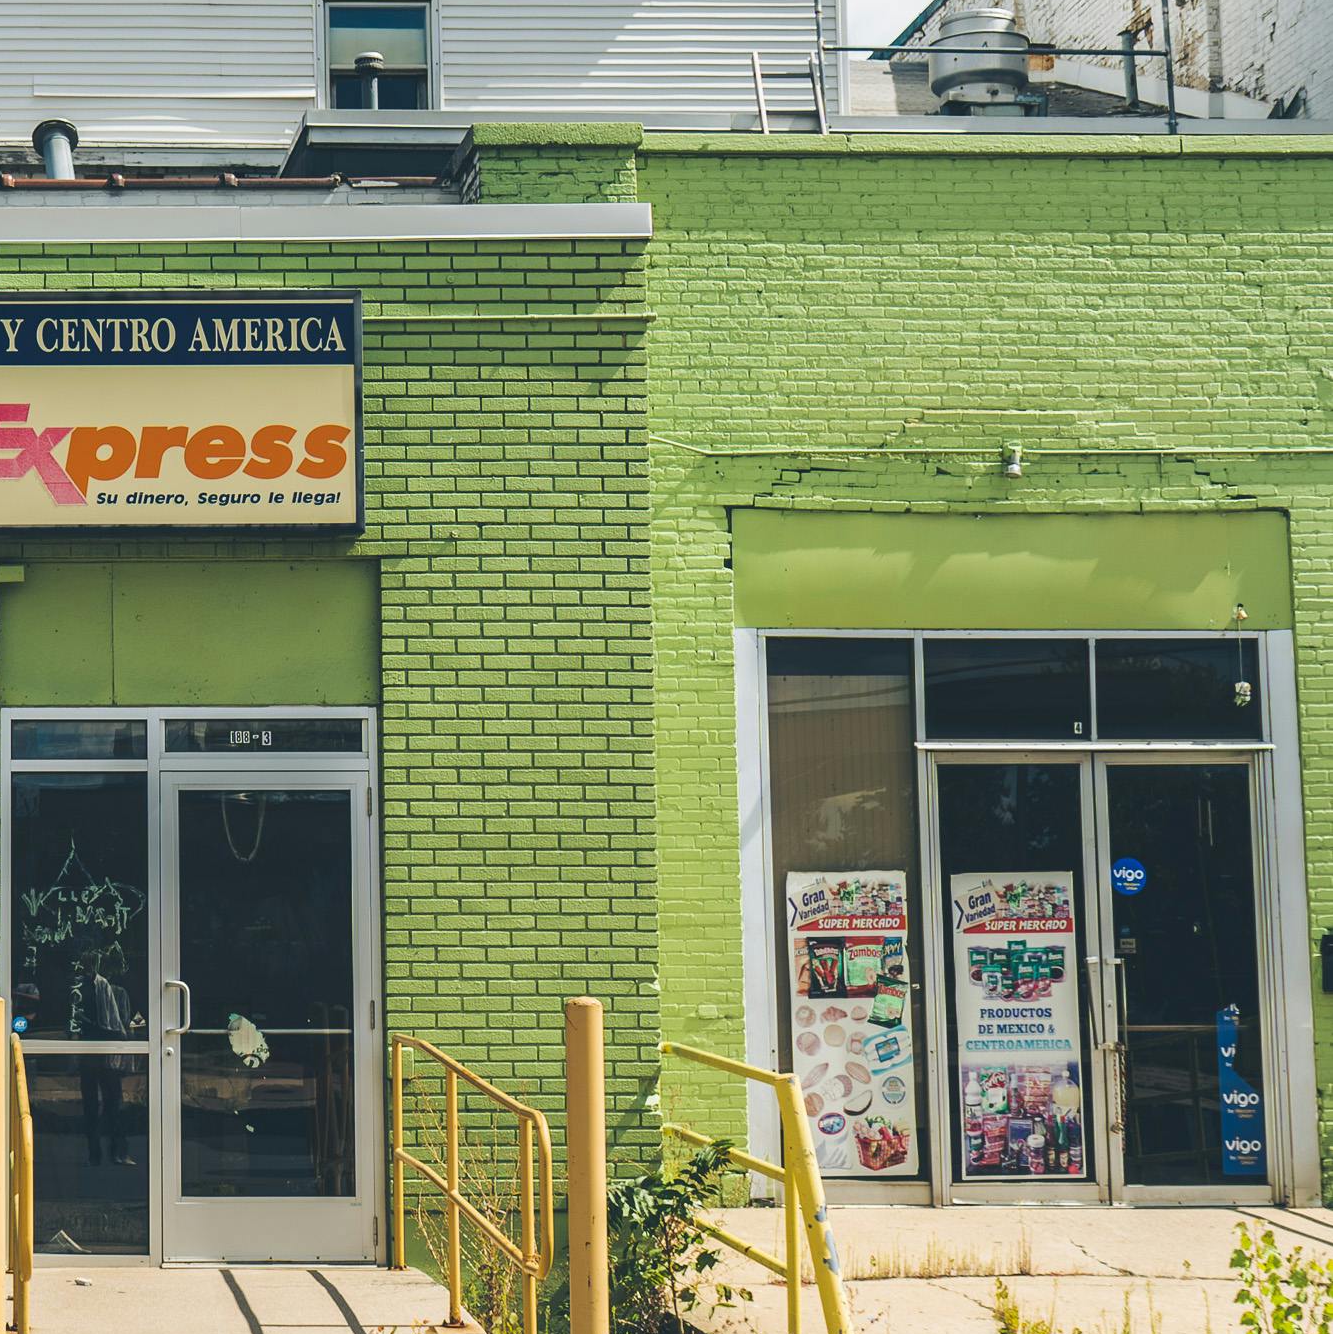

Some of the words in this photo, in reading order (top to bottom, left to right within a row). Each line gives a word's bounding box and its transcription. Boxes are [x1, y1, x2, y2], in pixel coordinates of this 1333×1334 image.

[0, 318, 24, 353] Y
[36, 317, 177, 354] CENTRO
[188, 316, 347, 353] AMERICA
[96, 492, 117, 504] Su
[125, 492, 189, 506] dinero,
[197, 492, 261, 506] Seguro
[268, 492, 285, 504] le
[291, 492, 342, 505] llega!
[1113, 866, 1144, 882] vigo
[802, 890, 825, 907] Gran
[968, 892, 991, 909] Gran
[798, 901, 829, 921] Variedad
[965, 904, 996, 923] Variedad
[818, 918, 850, 929] SUPER
[852, 918, 901, 929] MERCADO
[985, 920, 1016, 931] SUPER
[1018, 919, 1068, 930] MERCADO
[980, 1008, 1052, 1019] PRODUCTOS
[978, 1024, 993, 1034] DE
[996, 1024, 1045, 1034] MEXICO
[1047, 1024, 1055, 1034] &
[966, 1039, 1072, 1051] CENTROAMERICA
[1223, 1090, 1259, 1107] vigo
[1225, 1136, 1261, 1154] vigo
